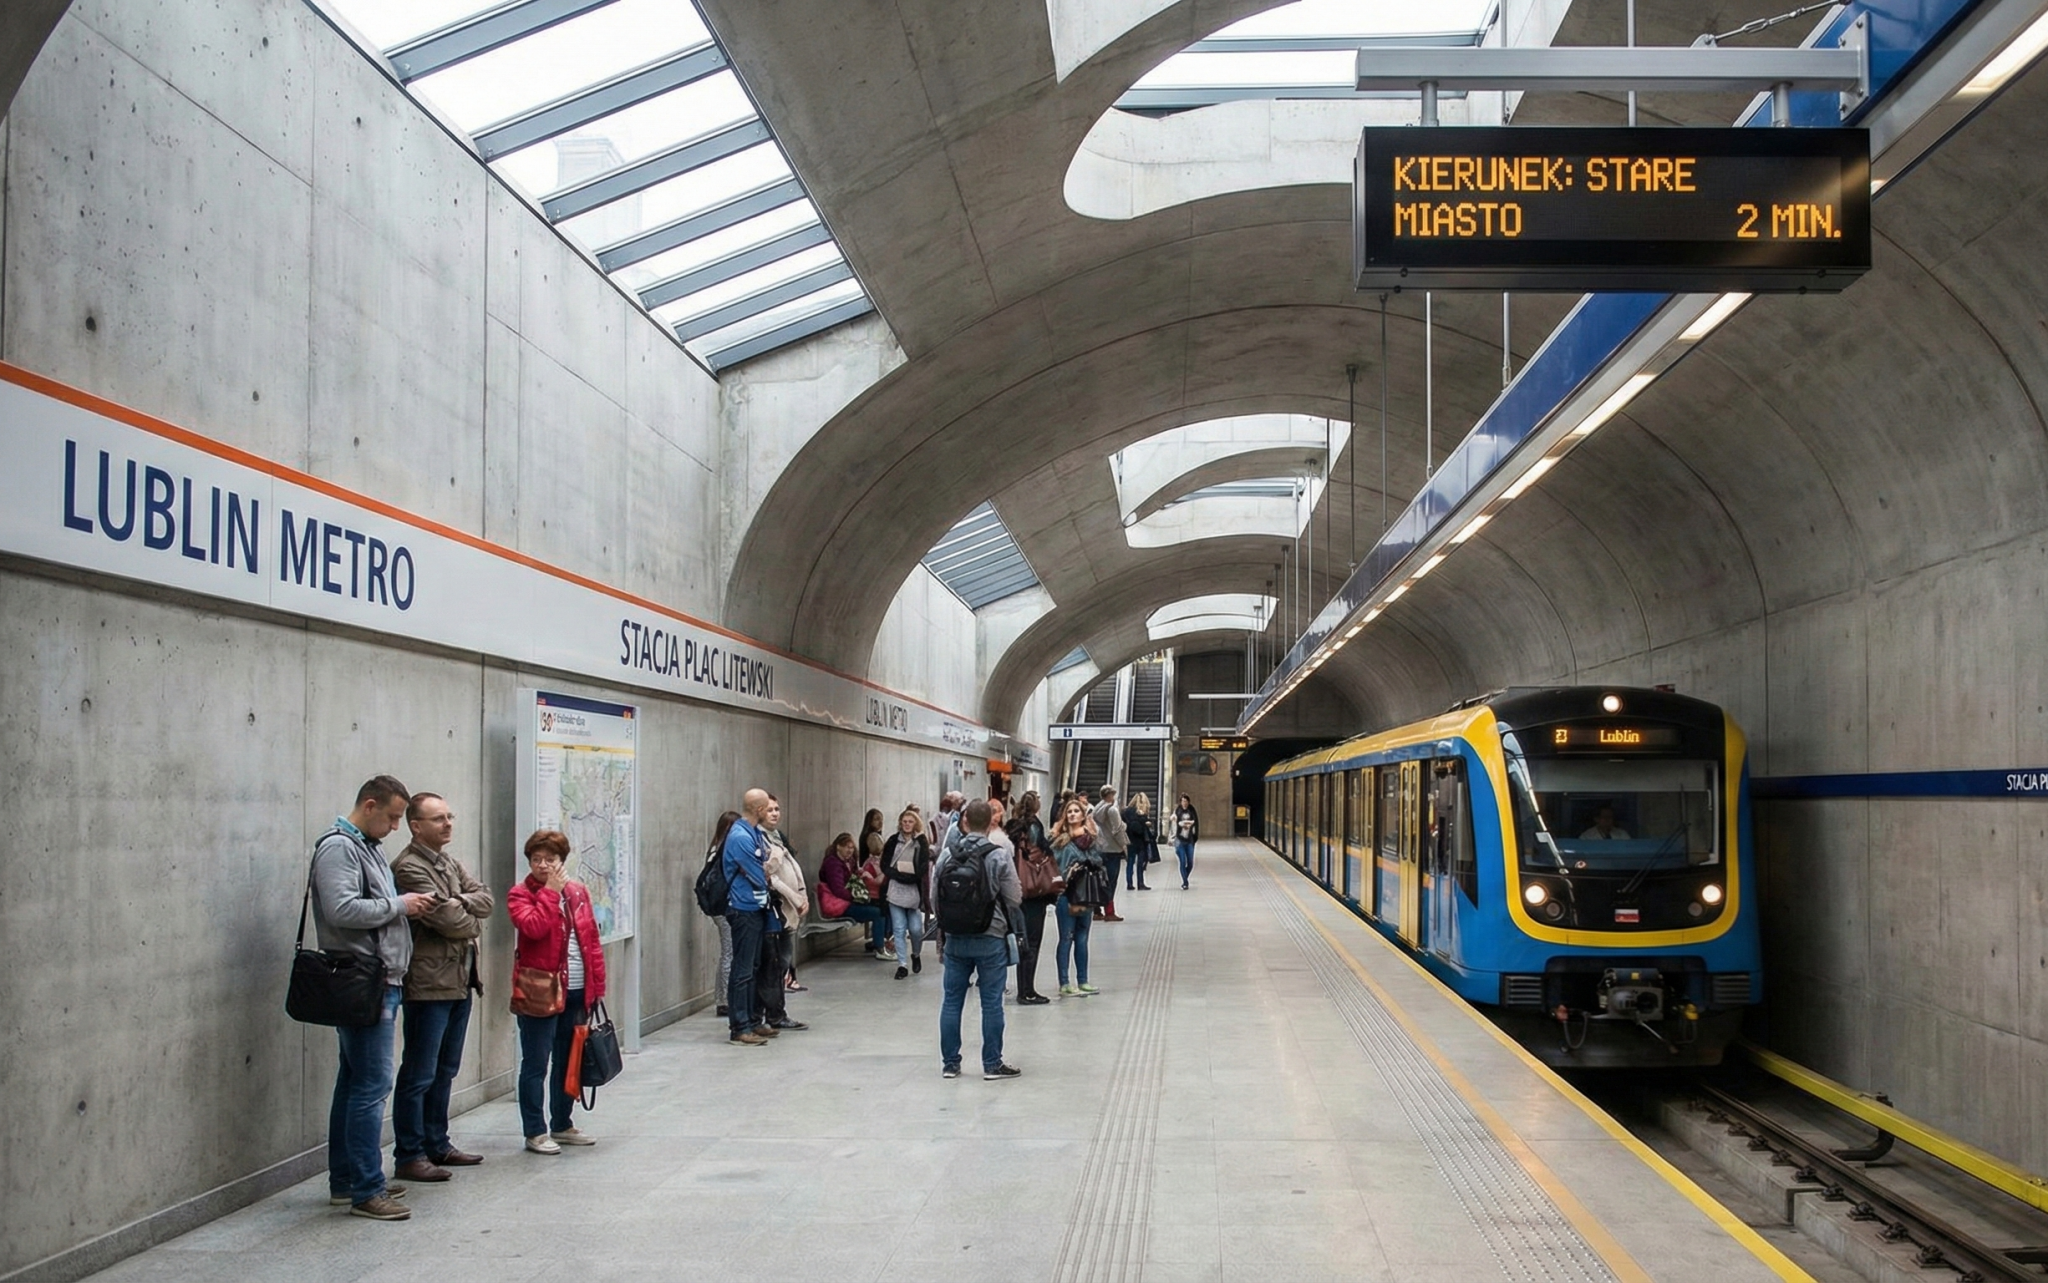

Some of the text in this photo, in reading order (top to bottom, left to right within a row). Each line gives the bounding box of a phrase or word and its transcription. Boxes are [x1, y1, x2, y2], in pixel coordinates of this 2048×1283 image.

[1394, 156, 1697, 192] KIERUNEK: STARE
[1394, 202, 1842, 238] MIASTO 2 MIN.
[63, 438, 415, 611] LUBLIN METRO
[620, 618, 774, 700] STACJA PLAC LITEWSKI
[1600, 729, 1640, 743] Lublin
